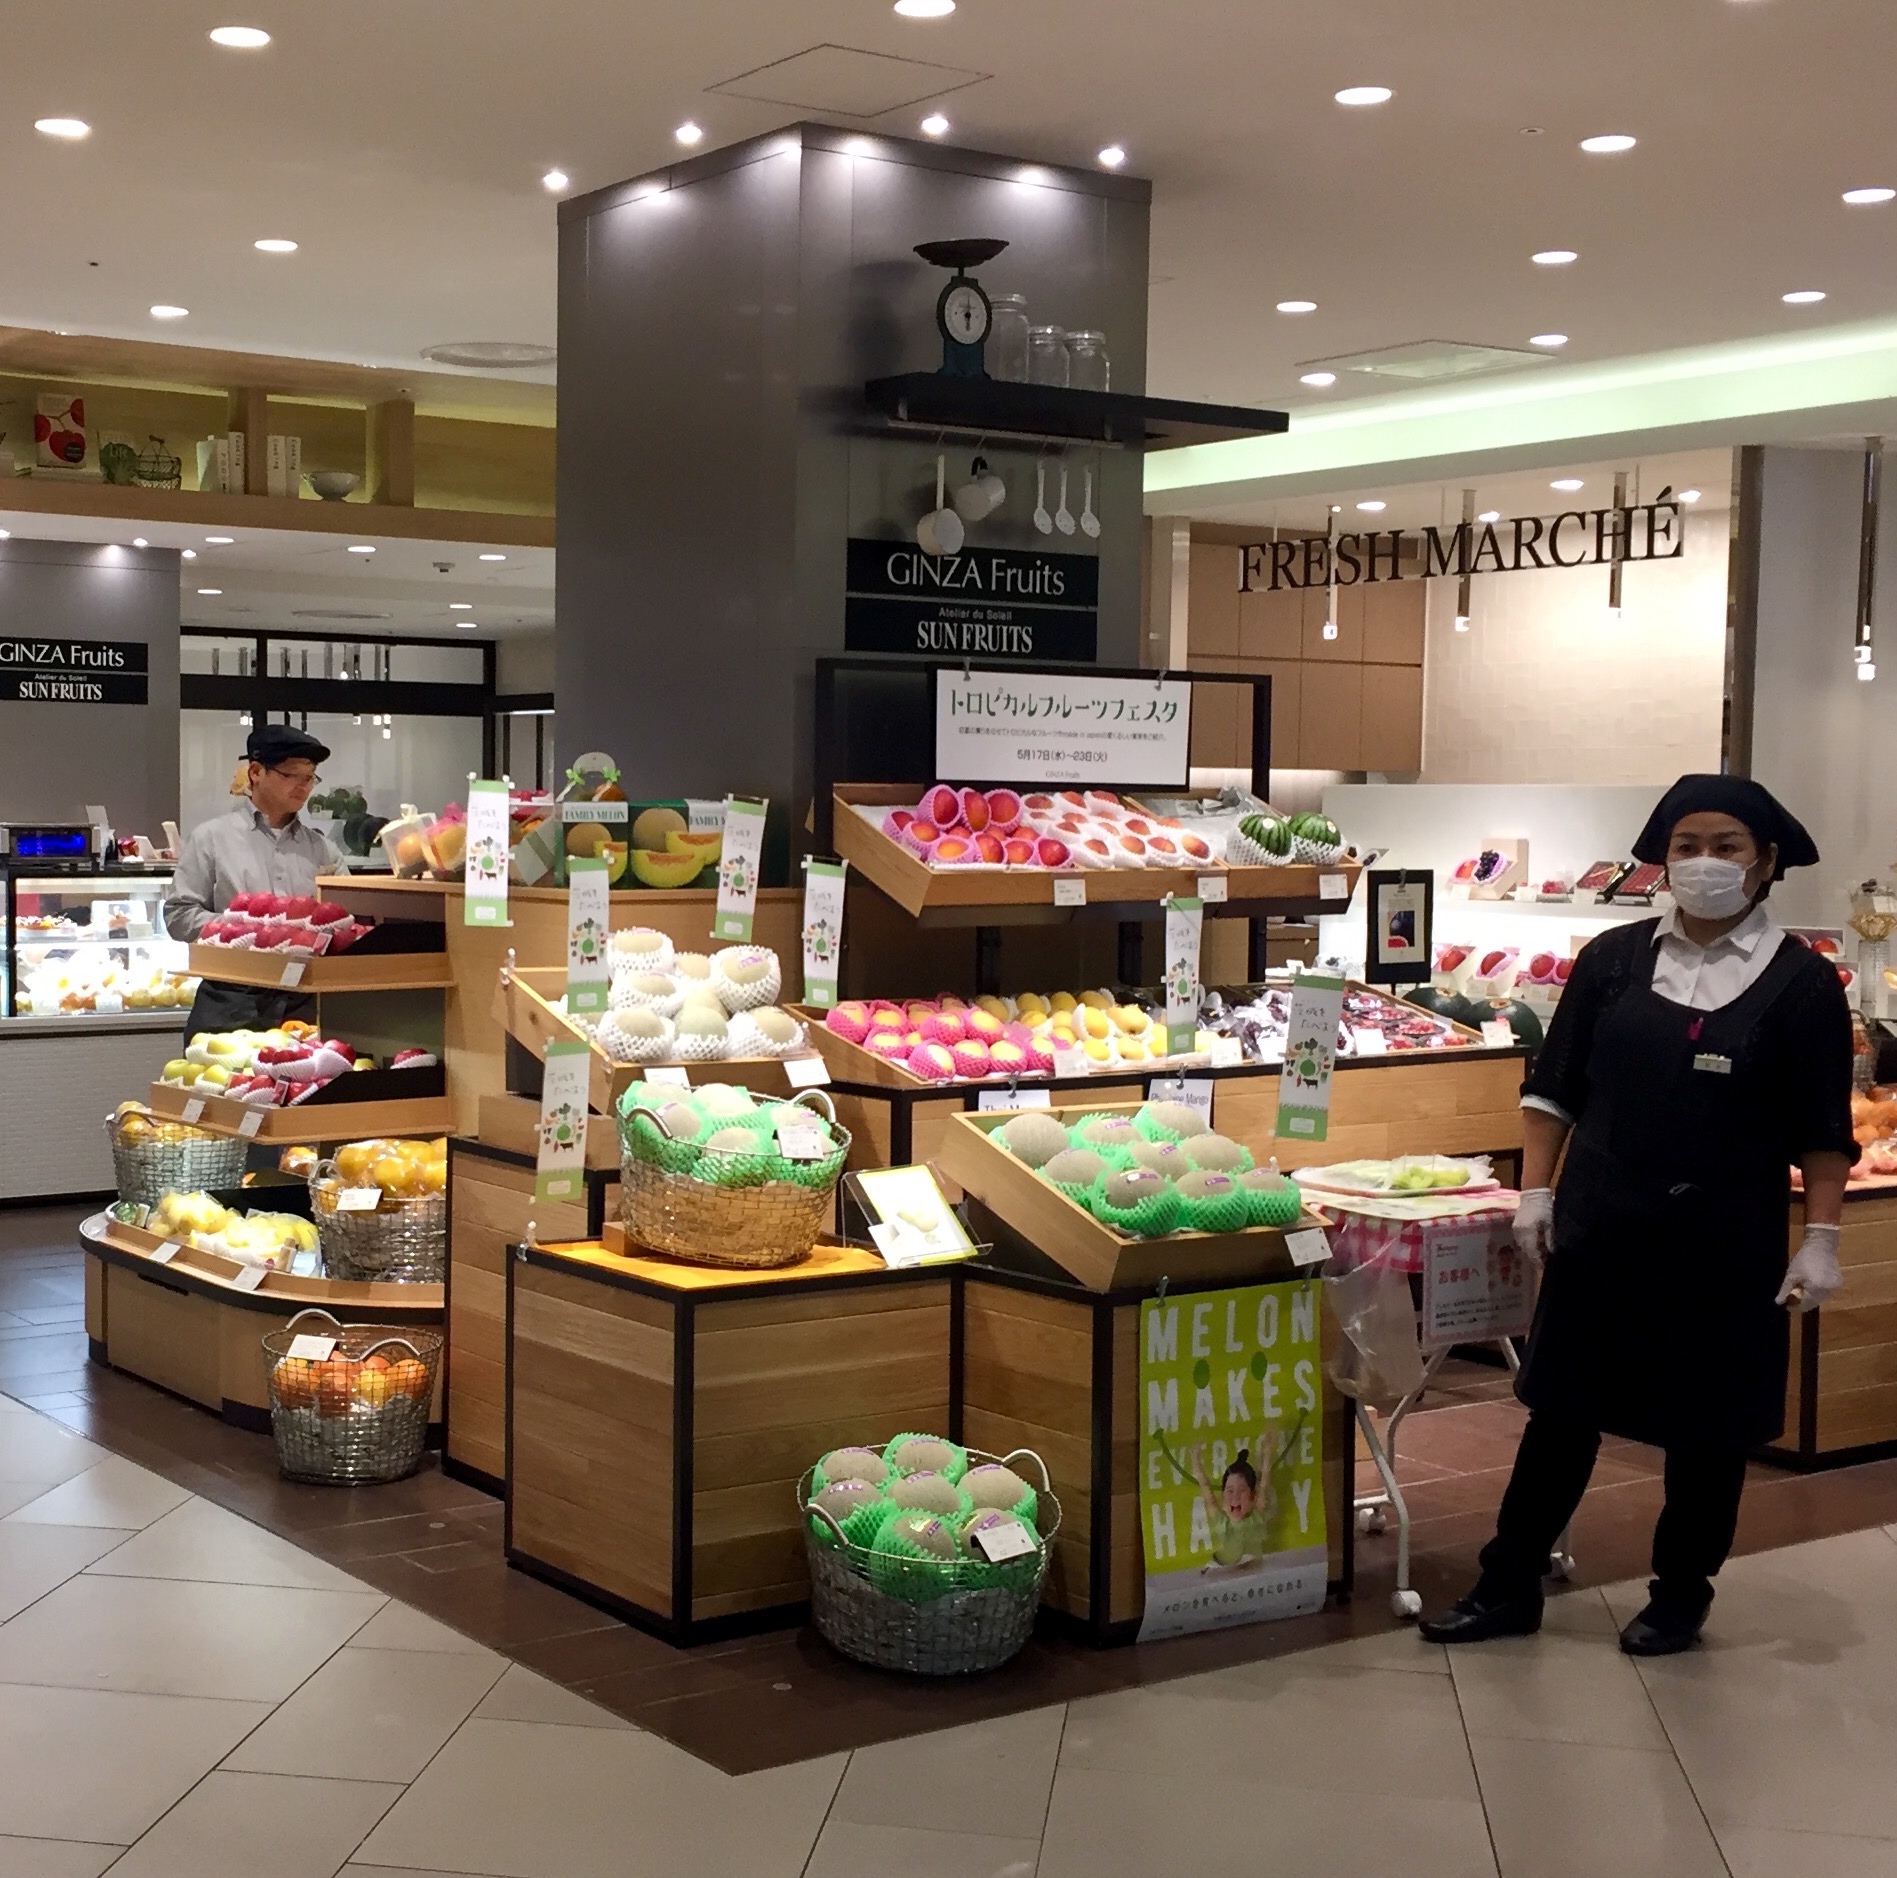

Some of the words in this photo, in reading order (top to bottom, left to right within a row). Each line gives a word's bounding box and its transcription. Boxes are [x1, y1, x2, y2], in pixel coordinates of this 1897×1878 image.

[1238, 529, 1405, 593] FRESH
[1421, 486, 1684, 578] MARCHÉ
[887, 552, 982, 589] GINZA
[991, 558, 1065, 596] Fruits
[972, 610, 984, 619] du
[0, 642, 65, 664] GINZA
[70, 645, 125, 667] Fruits
[917, 620, 957, 650] SUN
[962, 623, 1033, 654] FRUITS
[19, 681, 48, 699] SUN
[51, 682, 103, 700] FRUITS
[951, 686, 1178, 723] トロピカルフルーツフェスタ
[1147, 1290, 1314, 1363] MELON
[1147, 1359, 1316, 1434] MAKES
